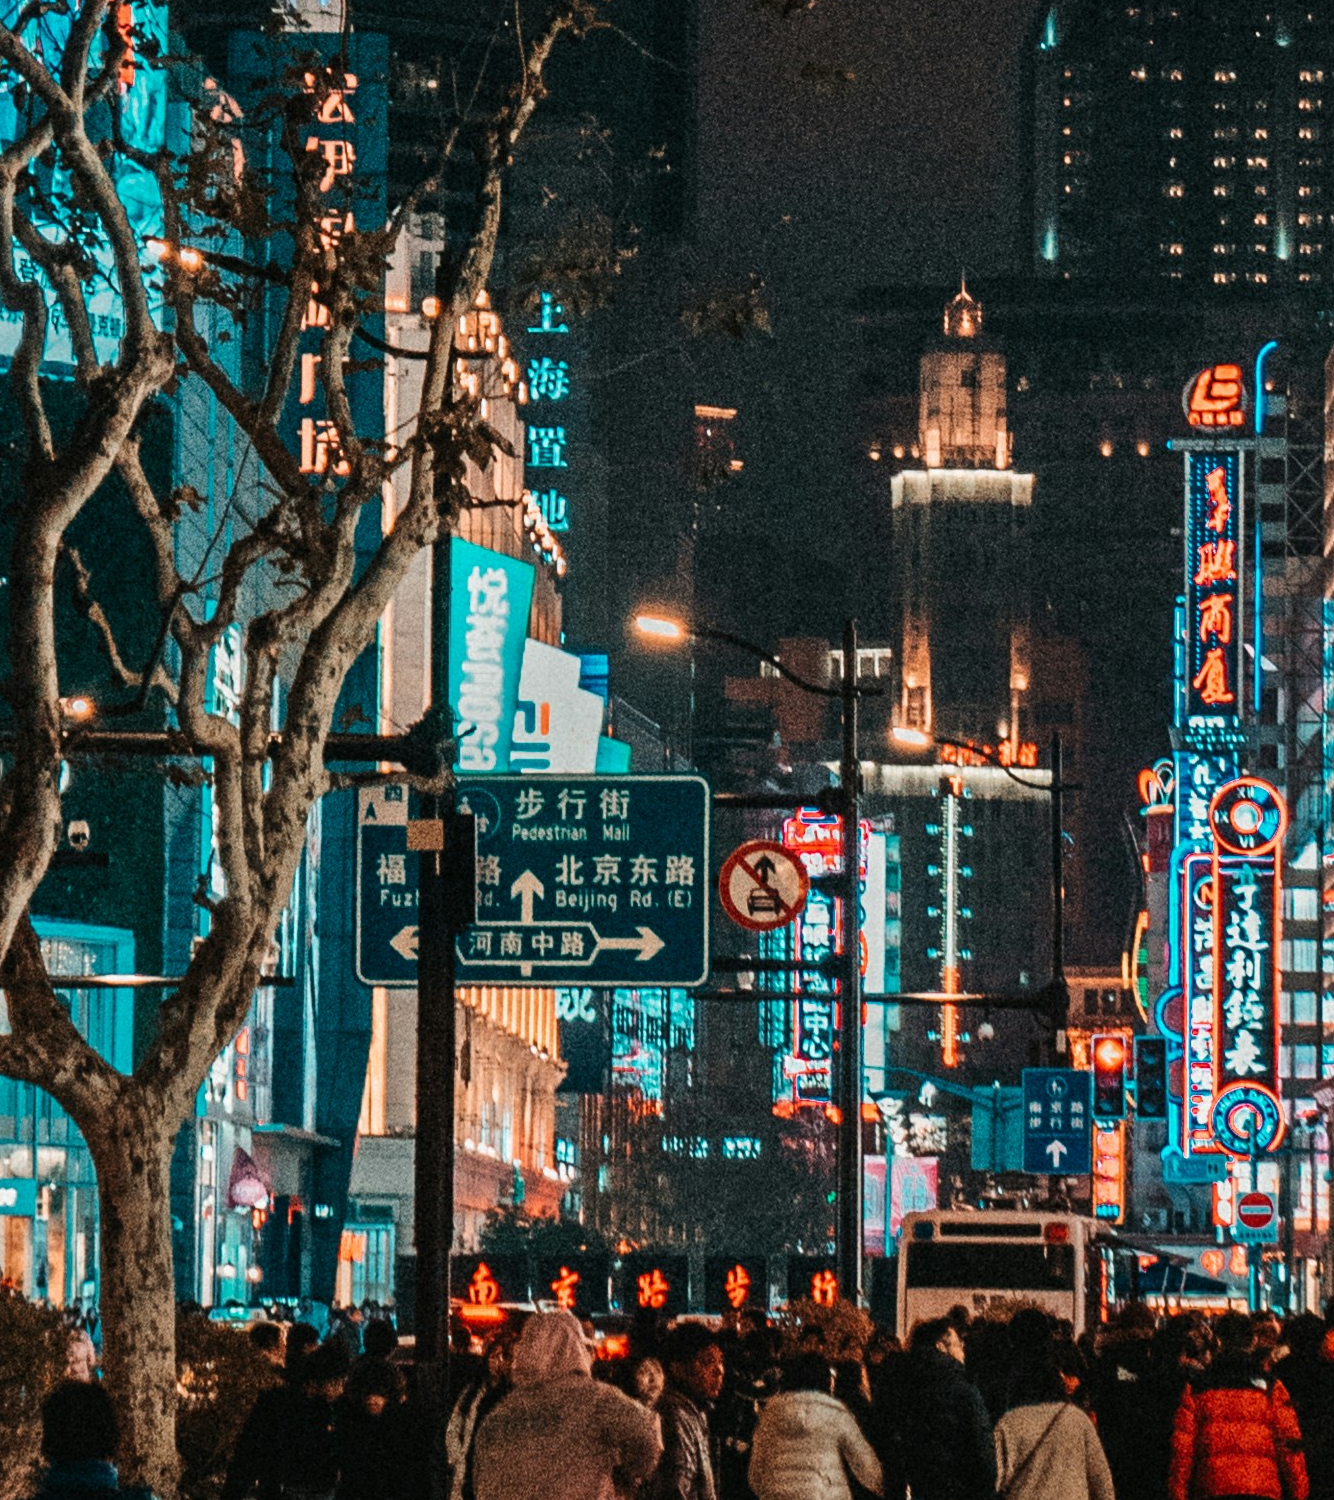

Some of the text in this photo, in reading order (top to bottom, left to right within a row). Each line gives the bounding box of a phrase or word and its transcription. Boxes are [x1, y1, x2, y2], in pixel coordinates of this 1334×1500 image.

[516, 787, 630, 820] 步行街
[511, 823, 630, 841] Pedestrian Mall
[555, 854, 696, 886] 北京东路
[555, 890, 618, 912] Beijing
[668, 891, 693, 909] (E)
[469, 930, 585, 957] 河南中路
